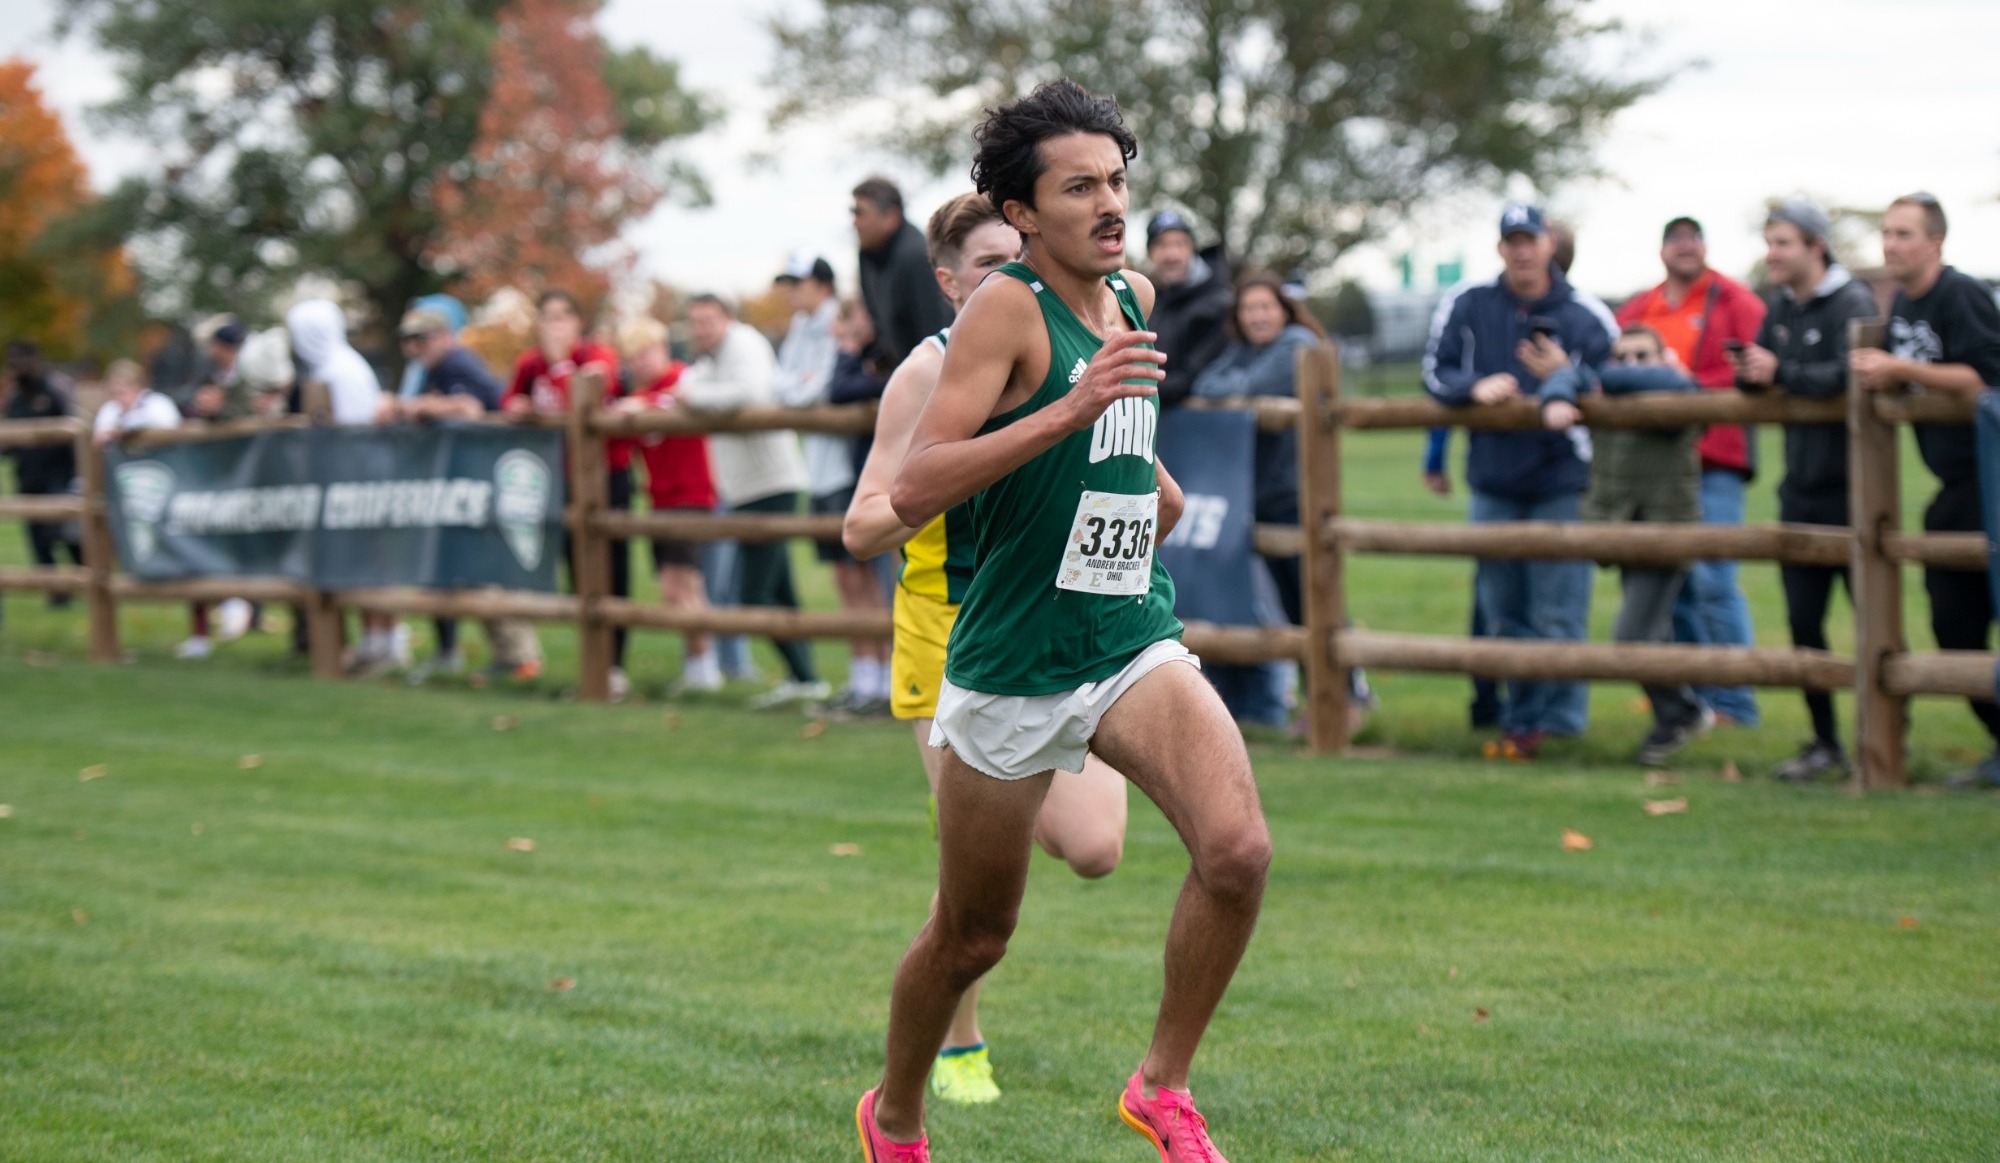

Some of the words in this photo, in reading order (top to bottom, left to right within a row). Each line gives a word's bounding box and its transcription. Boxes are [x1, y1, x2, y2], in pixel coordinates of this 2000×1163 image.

[1088, 397, 1156, 464] OHIO
[1080, 516, 1152, 560] 3336
[1085, 558, 1115, 570] ANDREW
[1106, 571, 1123, 581] OHIO
